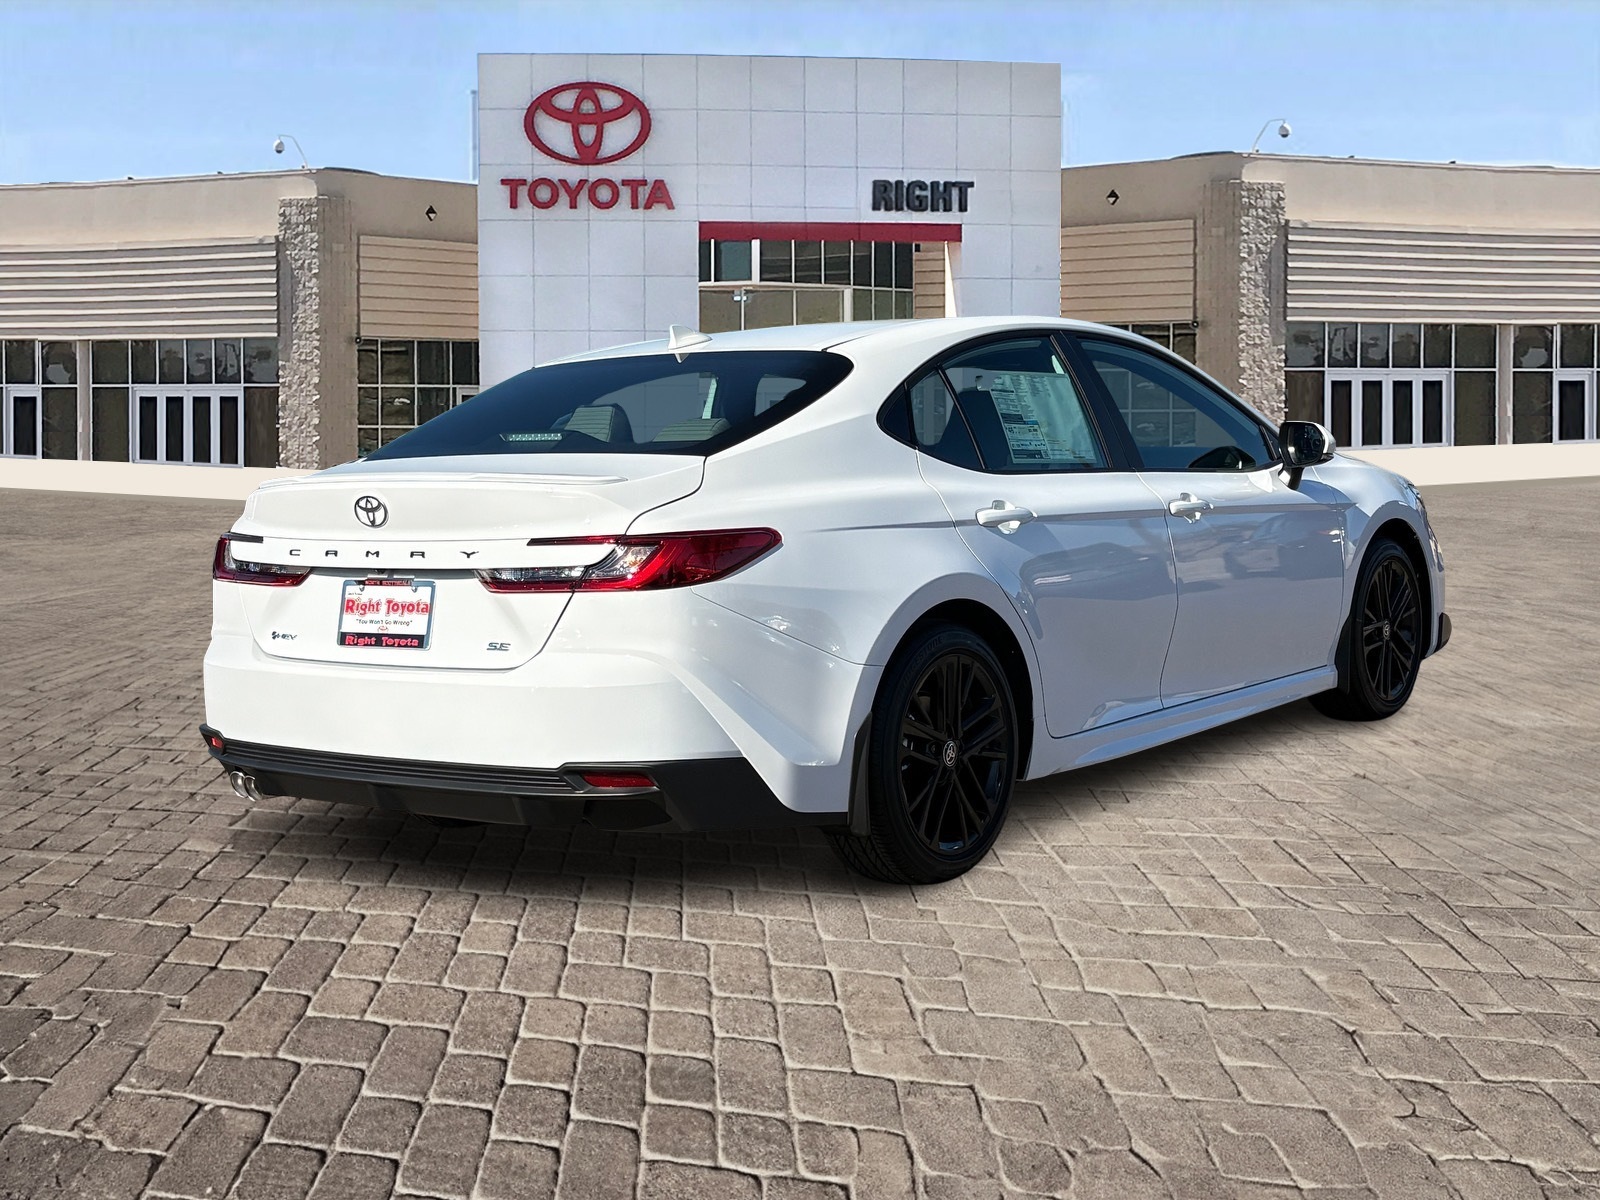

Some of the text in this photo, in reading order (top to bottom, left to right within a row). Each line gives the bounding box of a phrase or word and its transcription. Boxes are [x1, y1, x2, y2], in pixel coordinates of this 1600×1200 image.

[500, 178, 675, 210] TOYOTA
[872, 180, 974, 212] RIGHT
[289, 548, 479, 559] CAMRY
[345, 598, 430, 616] Right Toyota
[345, 635, 419, 646] Right Toyota
[486, 642, 511, 651] SE
